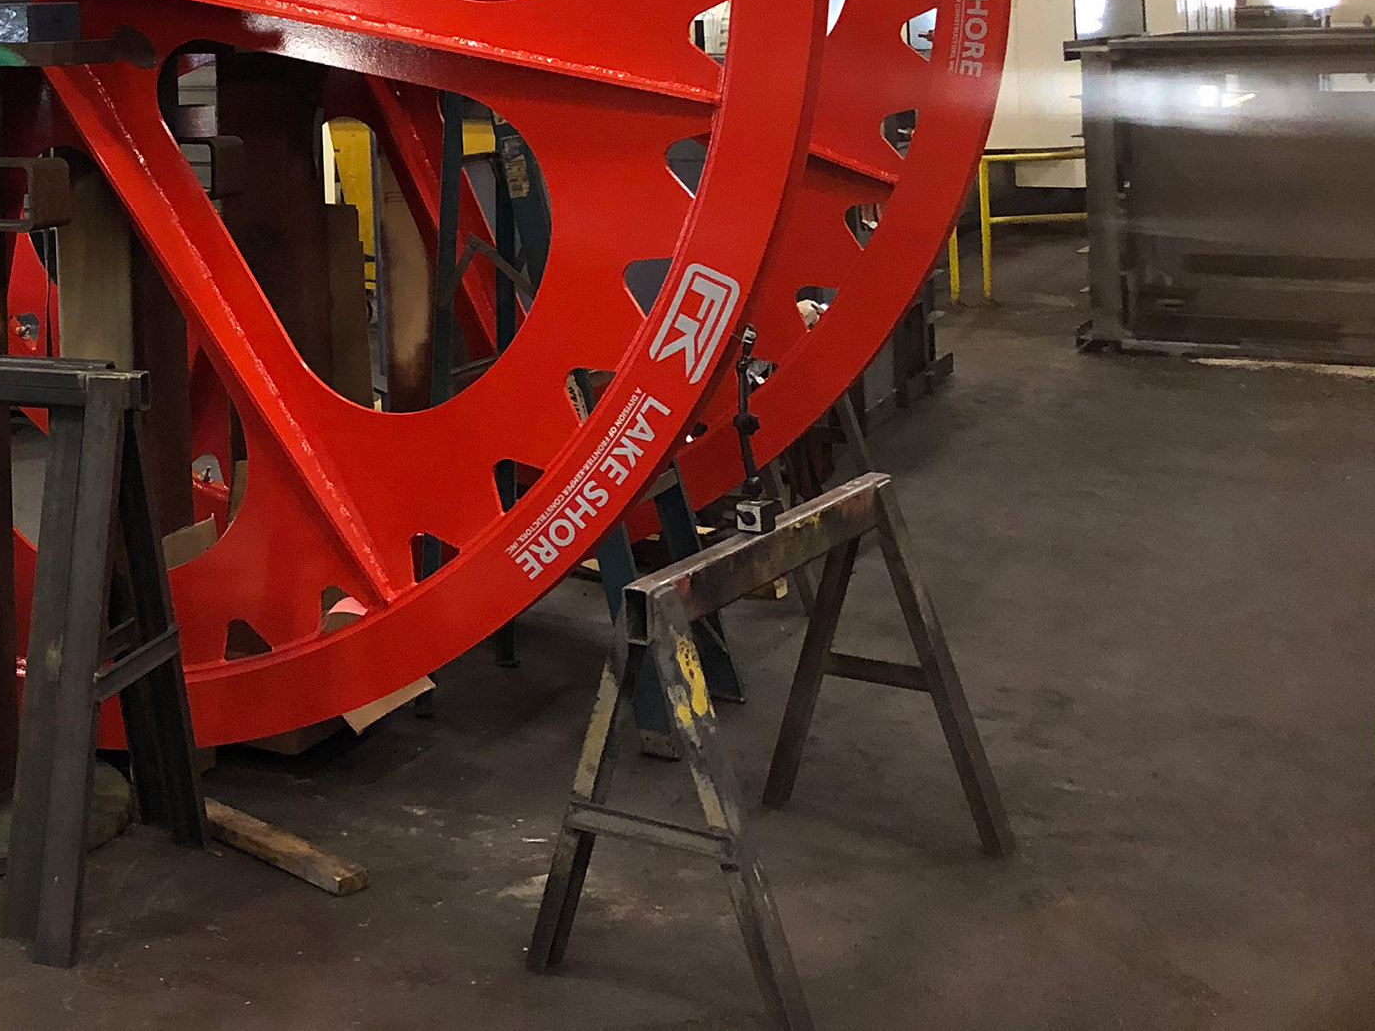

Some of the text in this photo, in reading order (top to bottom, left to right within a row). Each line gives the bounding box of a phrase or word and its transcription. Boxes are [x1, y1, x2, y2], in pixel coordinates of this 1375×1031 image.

[613, 393, 640, 429] DIVISION
[635, 387, 643, 395] A
[607, 426, 618, 439] OF
[568, 436, 610, 490] FRONTIER-KEMPER
[514, 396, 671, 580] LAKE SHORE
[519, 488, 568, 544] CONSTRUCTORS,
